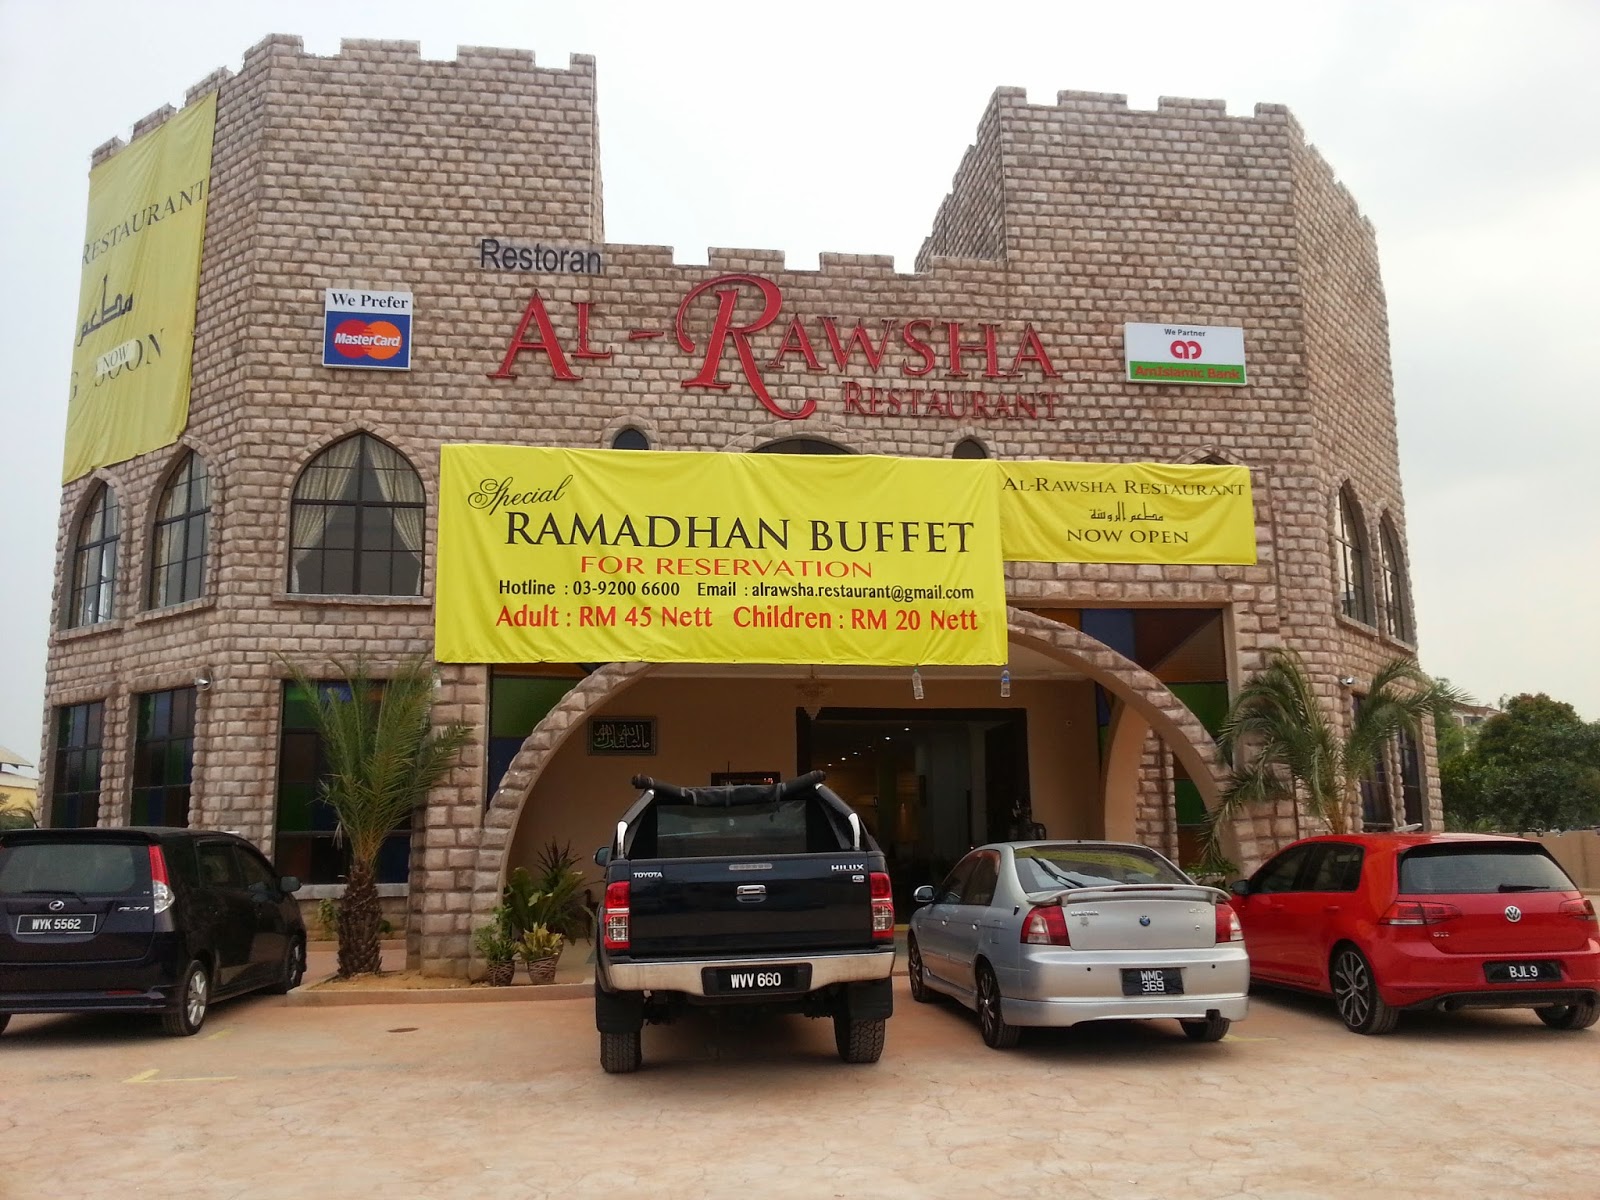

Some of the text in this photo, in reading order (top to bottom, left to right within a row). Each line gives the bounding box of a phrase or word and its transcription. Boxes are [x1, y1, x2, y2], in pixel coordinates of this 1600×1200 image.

[481, 239, 601, 274] Restoran
[332, 293, 409, 309] We Prefer
[334, 333, 401, 347] MasterCard
[1164, 328, 1206, 337] We Partner
[1207, 368, 1240, 379] Bank
[842, 381, 1063, 421] RESTAURANT
[1002, 477, 1245, 496] AL-RAWSHA RESTAURANT
[467, 474, 574, 516] Special
[504, 511, 975, 553] RAMADHAN BUFFET
[1067, 529, 1189, 544] NOW OPEN
[580, 556, 873, 578] FOR RESERVATION
[499, 579, 556, 595] Hotline
[573, 580, 637, 596] 03-9200
[641, 581, 680, 596] 6600
[697, 582, 737, 597] Email
[751, 582, 974, 603] alrawsha.restaurant@gmail.com
[496, 604, 560, 627] Adult
[579, 606, 616, 627] RM
[624, 606, 652, 627] 45
[661, 606, 713, 627] Nett
[733, 605, 832, 628] Children
[851, 608, 887, 630] RM
[895, 609, 921, 630] 20
[930, 609, 978, 630] Nett
[633, 871, 664, 879] TOYOTA
[831, 864, 865, 872] HILUX
[32, 918, 82, 930] WYK 5562
[1140, 970, 1164, 981] WMC
[1508, 965, 1539, 978] BJL 9
[730, 973, 782, 989] WVV 660
[1141, 980, 1165, 991] 369
